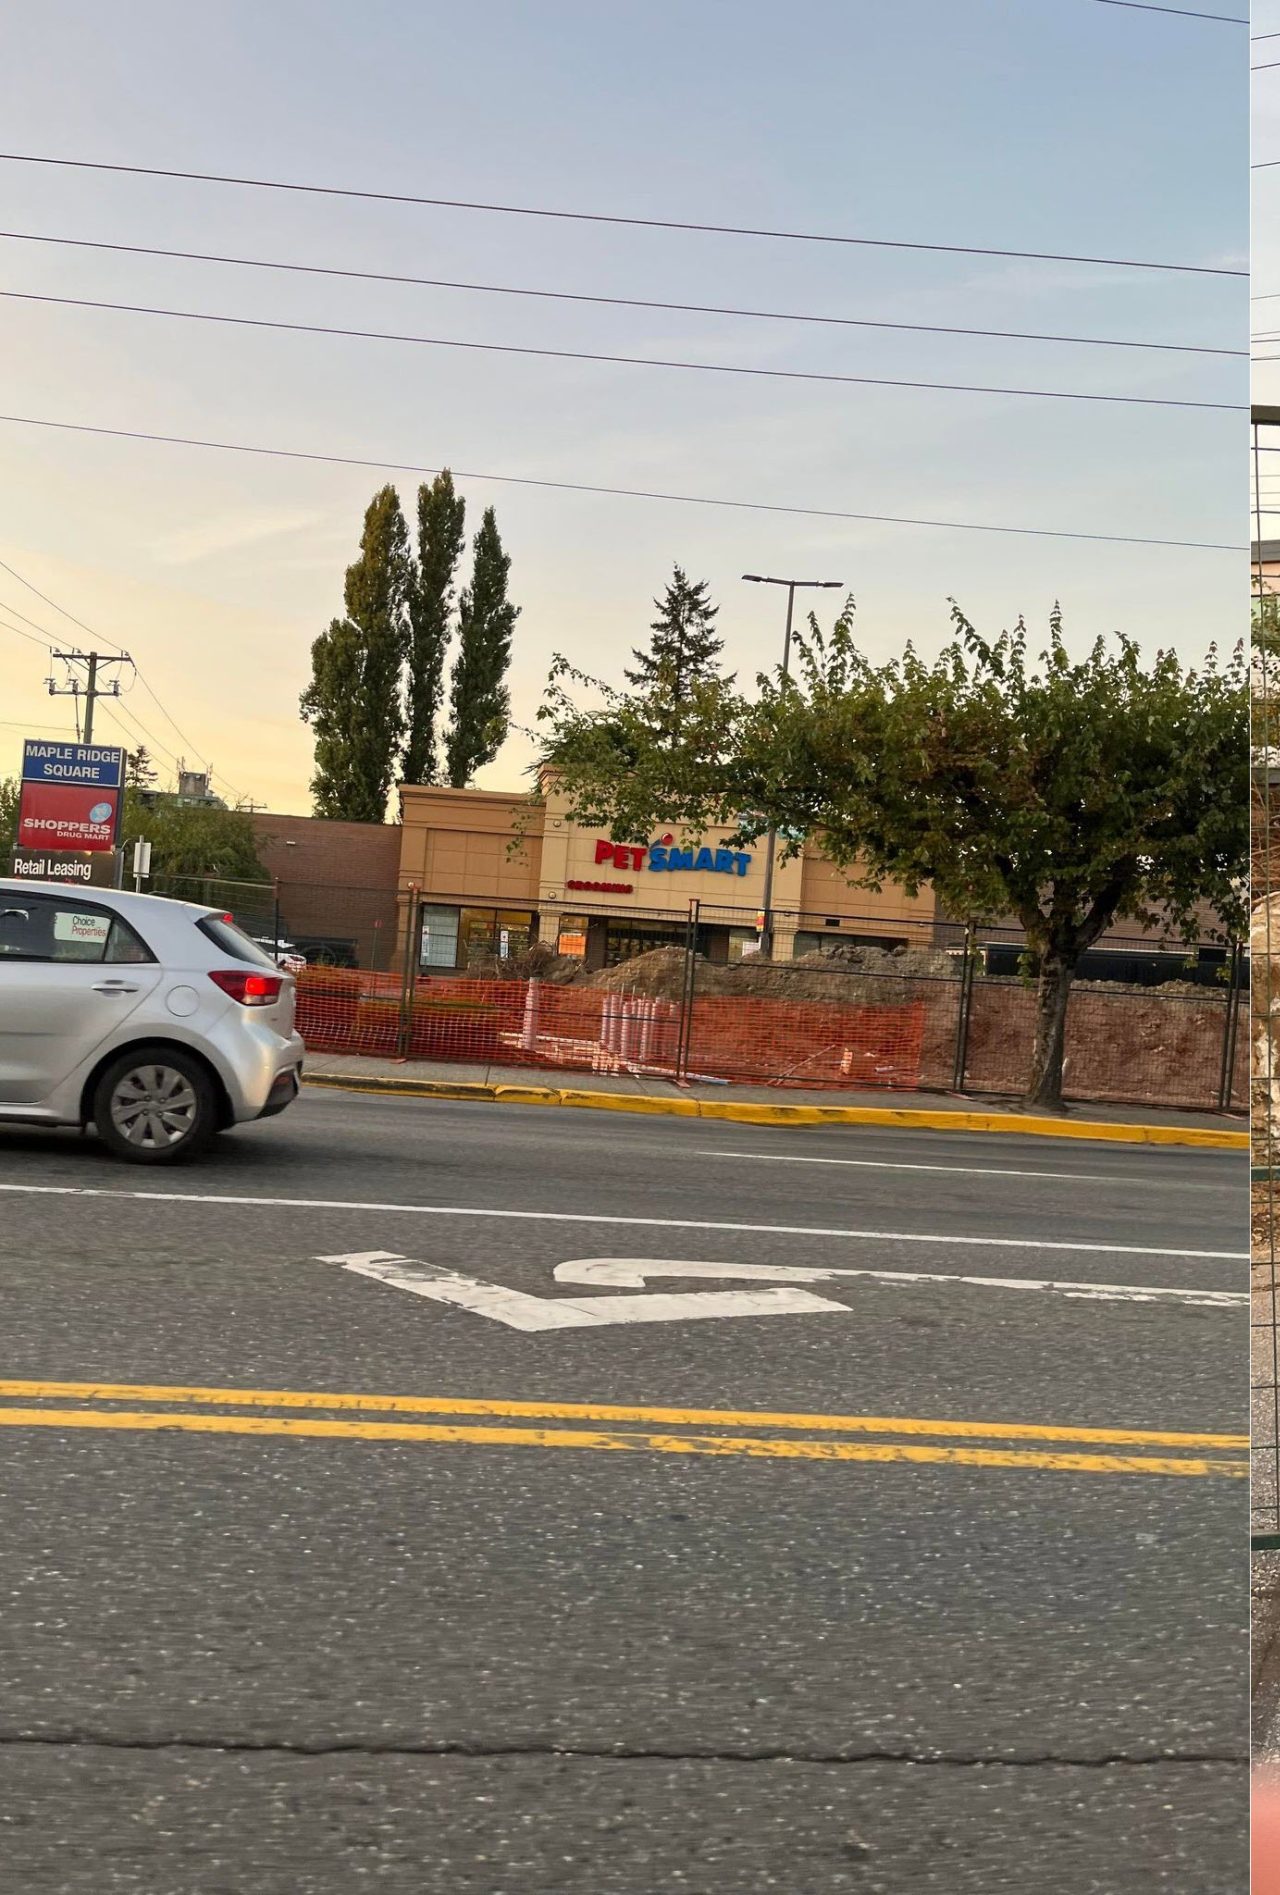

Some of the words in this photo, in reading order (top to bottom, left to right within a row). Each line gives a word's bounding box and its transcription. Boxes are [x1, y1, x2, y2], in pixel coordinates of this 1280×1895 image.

[25, 745, 73, 760] MAPLE
[77, 749, 120, 763] RIDGE
[43, 763, 100, 779] SQUARE
[23, 818, 111, 834] SHOPPERS
[56, 830, 82, 839] DRUG
[84, 833, 110, 841] MART
[14, 858, 45, 875] Retail
[47, 859, 92, 880] Leasing
[72, 915, 96, 926] Choice
[72, 925, 106, 937] Properties
